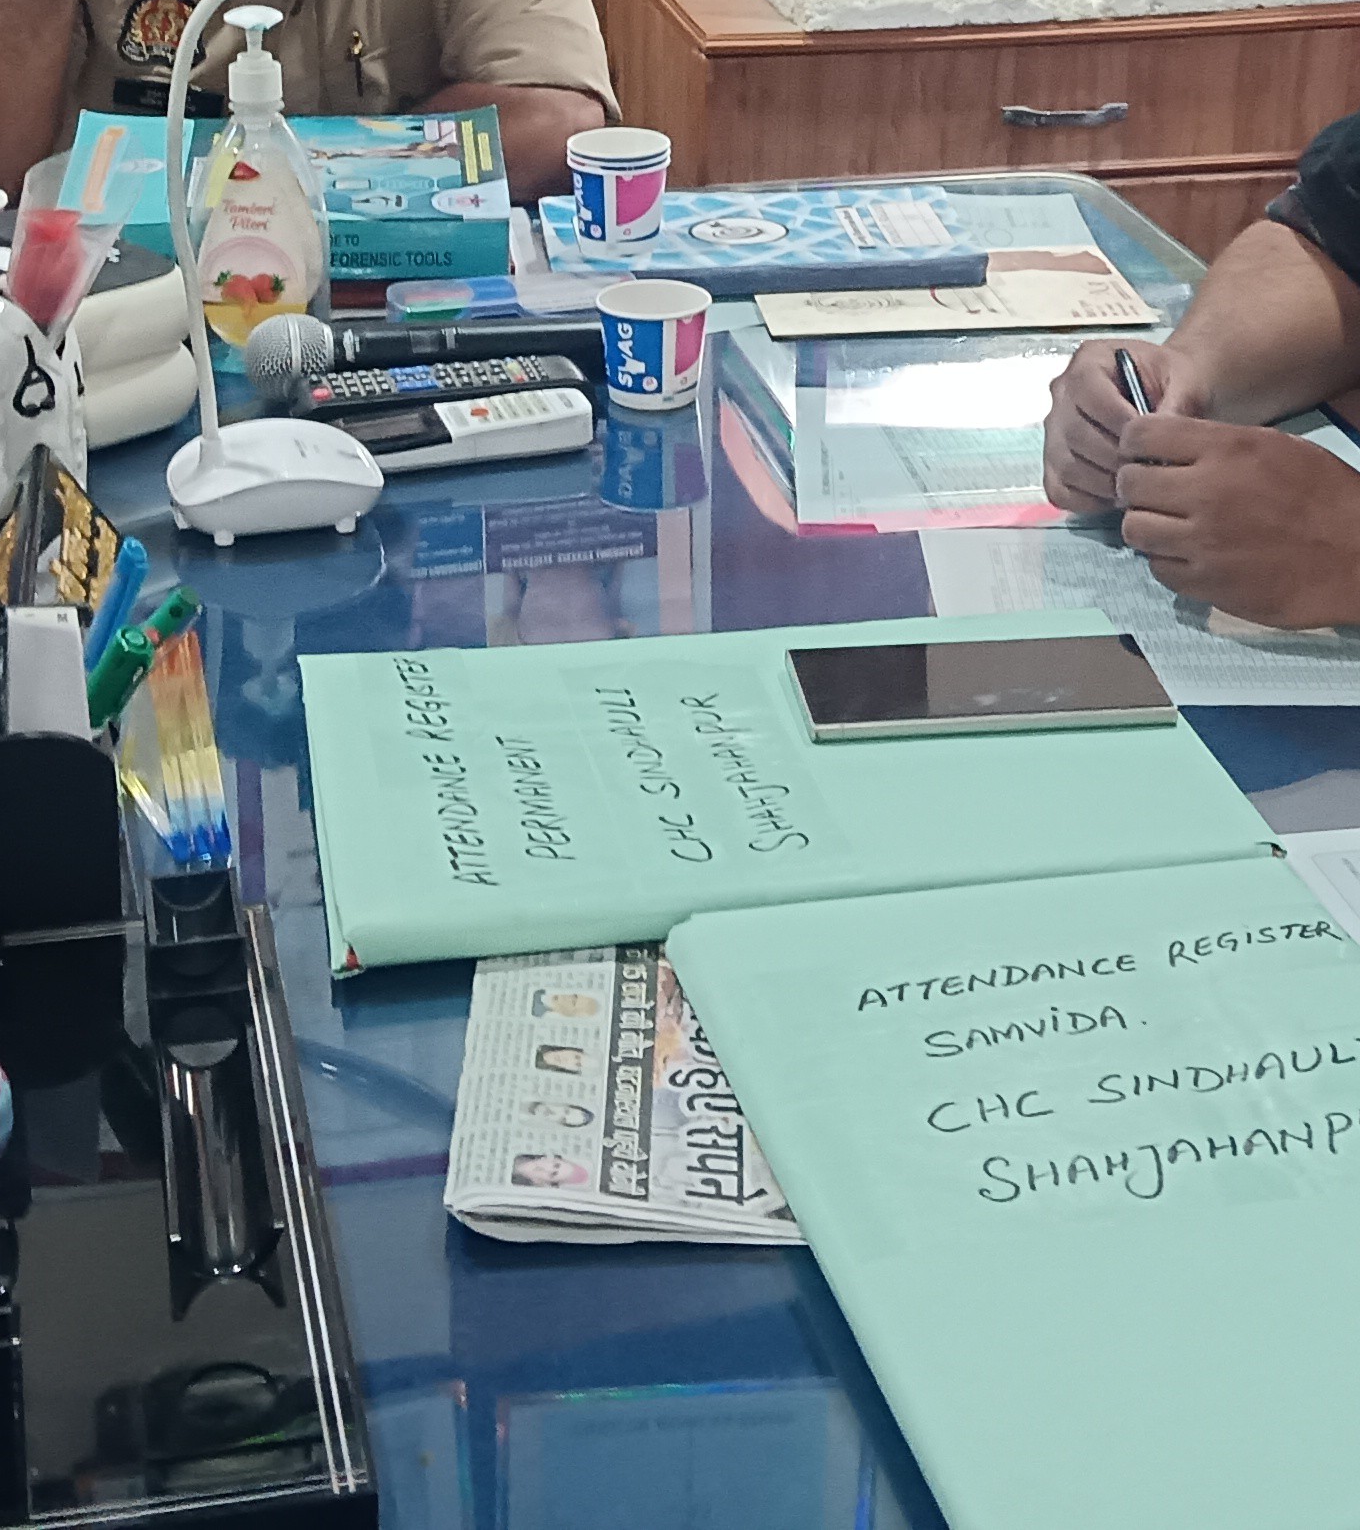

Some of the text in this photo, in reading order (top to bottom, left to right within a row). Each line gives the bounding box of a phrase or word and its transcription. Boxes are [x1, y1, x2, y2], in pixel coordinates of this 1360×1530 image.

[405, 251, 453, 267] TOOLS
[422, 751, 500, 887] ATTENDANCE
[495, 734, 577, 861] PERMANENT
[658, 812, 713, 863] CHC
[856, 952, 1138, 1012] ATTENDANCE
[926, 1088, 1055, 1133] CHC
[686, 1123, 768, 1206] सपने
